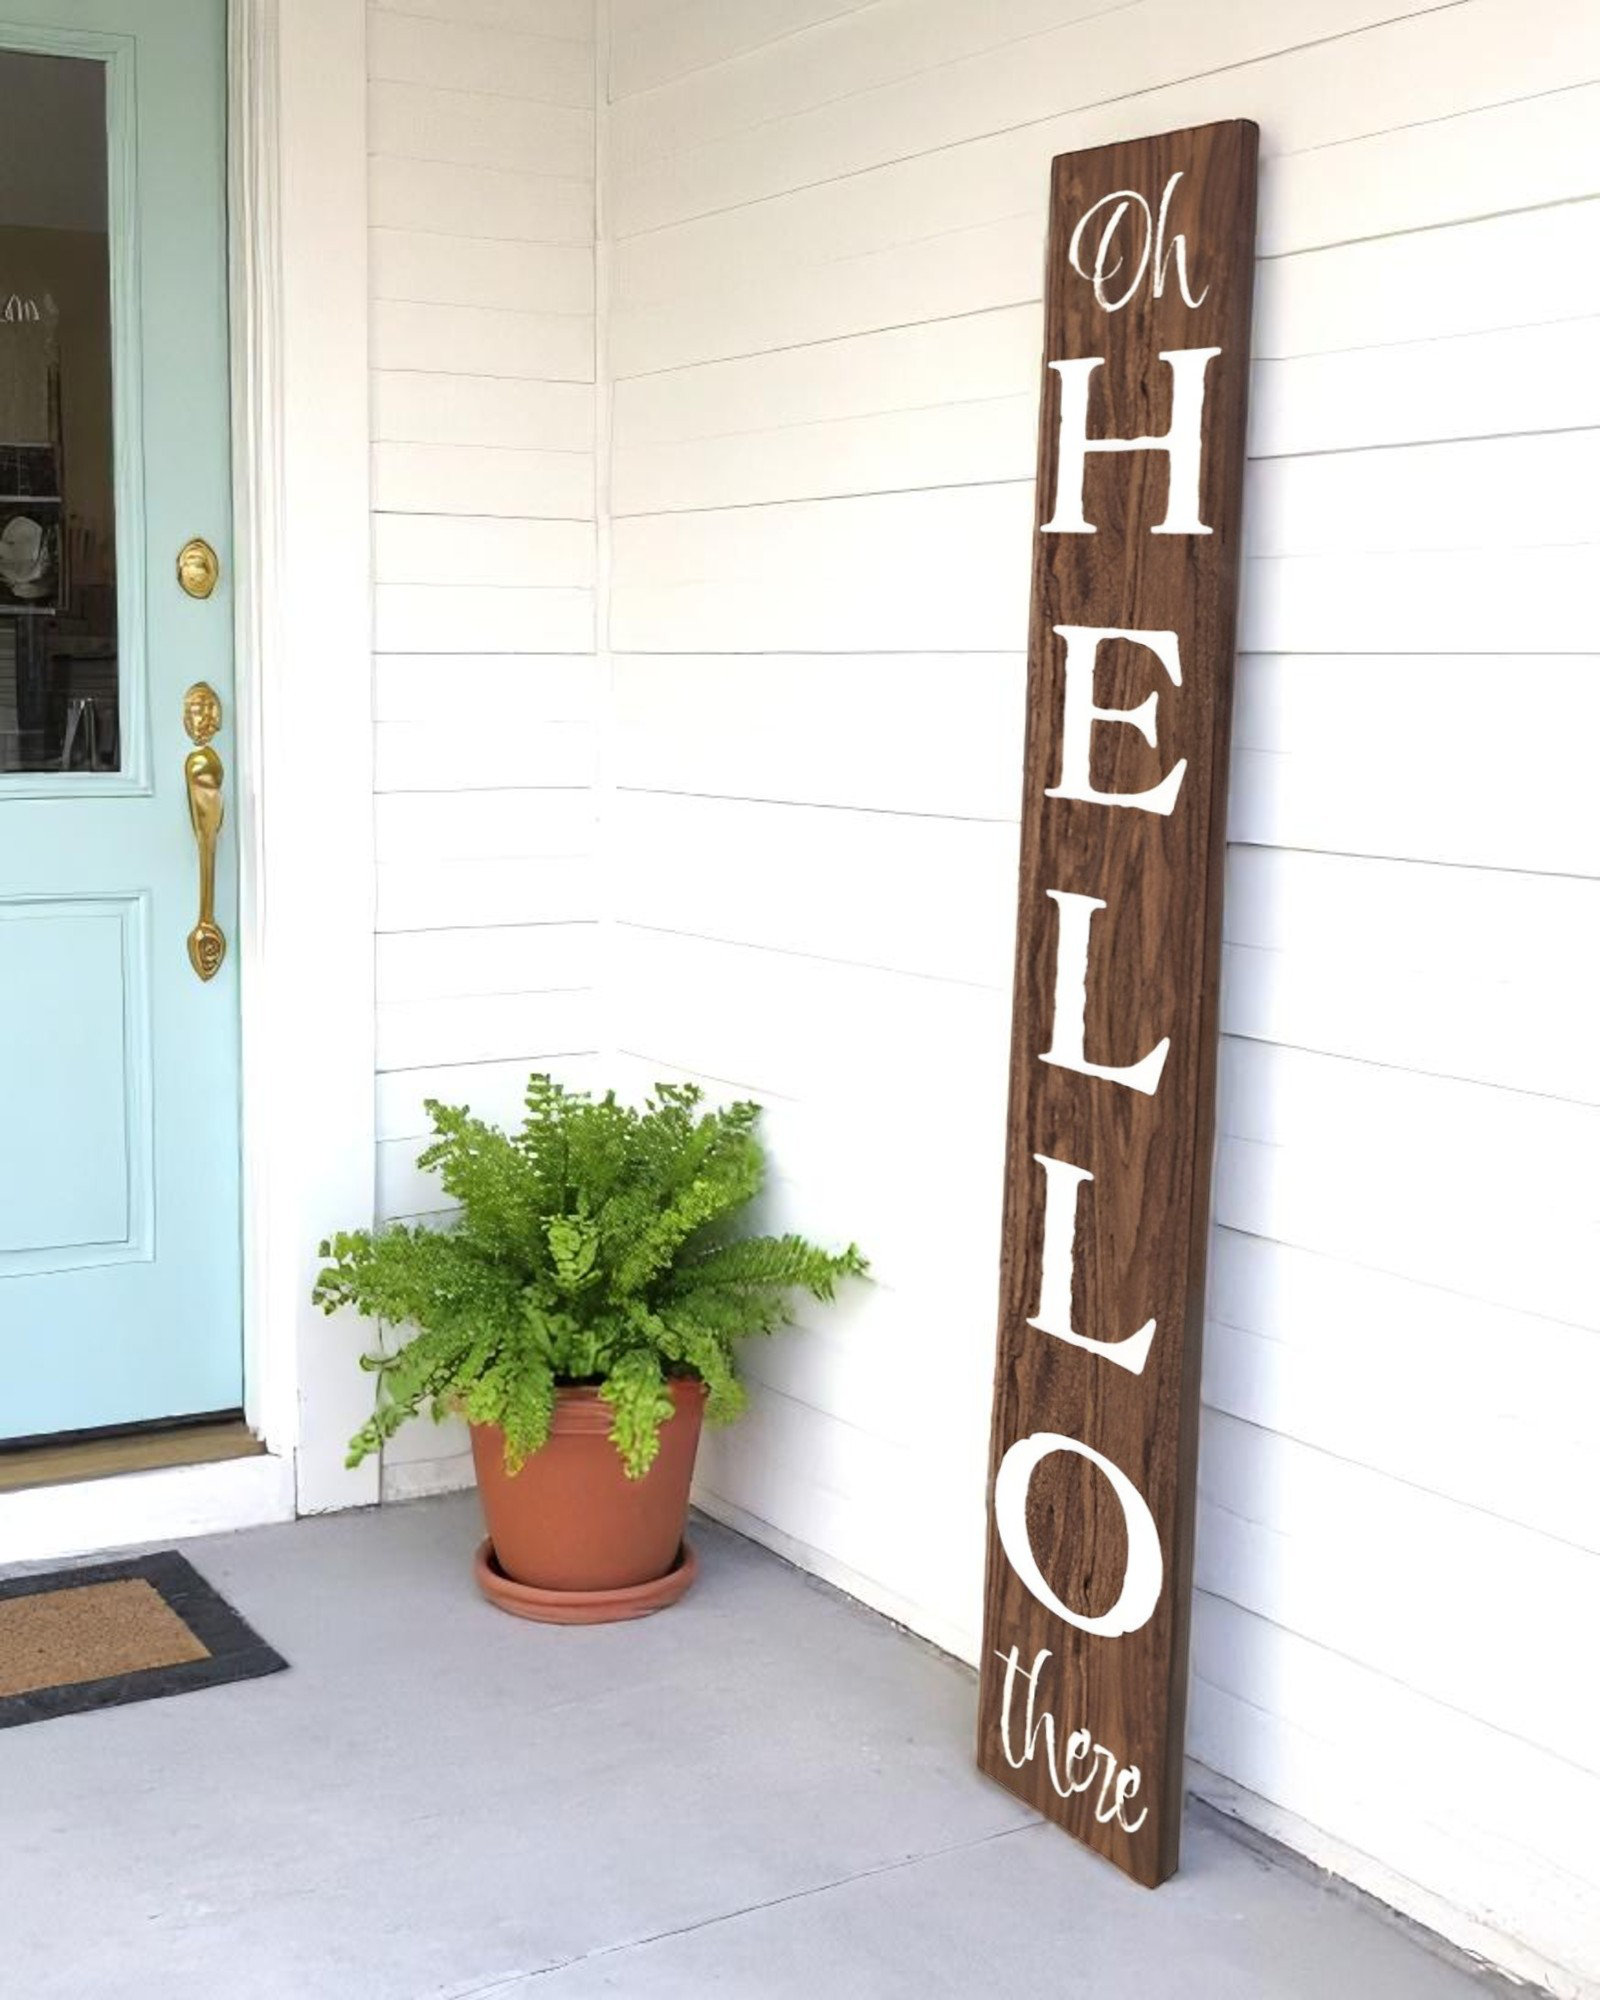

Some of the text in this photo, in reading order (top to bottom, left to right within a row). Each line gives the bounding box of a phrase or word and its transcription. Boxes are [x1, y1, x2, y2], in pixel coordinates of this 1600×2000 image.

[1068, 171, 1209, 313] Oh
[994, 346, 1222, 1638] HELLO
[993, 1644, 1149, 1834] there
